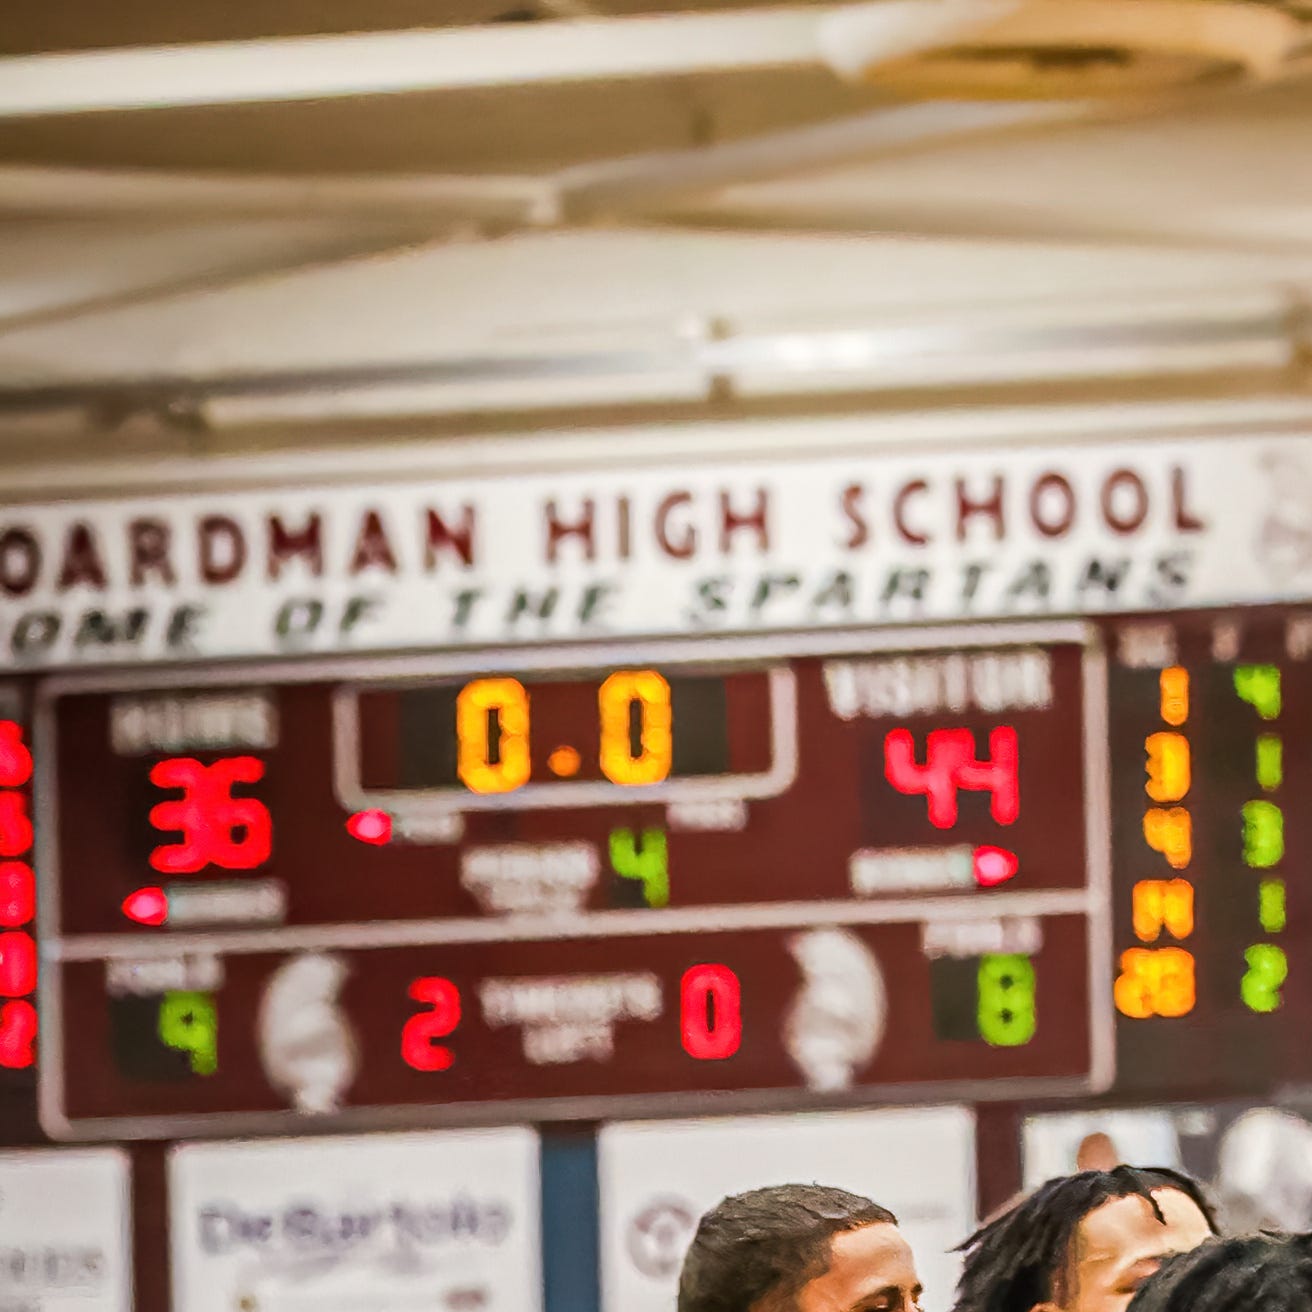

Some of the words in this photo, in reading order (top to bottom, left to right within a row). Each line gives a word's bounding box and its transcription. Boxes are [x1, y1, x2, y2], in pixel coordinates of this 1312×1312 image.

[0, 504, 475, 597] OARDMAN
[545, 487, 769, 565] HIGH
[841, 466, 1208, 551] SCHOOL
[273, 595, 383, 641] OF
[451, 584, 614, 628] THE
[684, 549, 1196, 618] SPARTANS
[456, 671, 671, 795] 0.0
[884, 725, 1020, 829] 44
[149, 756, 273, 873] 36
[608, 827, 669, 908] 4
[158, 990, 218, 1075] 9
[402, 976, 461, 1071] 2
[680, 963, 742, 1060] 0
[978, 953, 1036, 1047] 8
